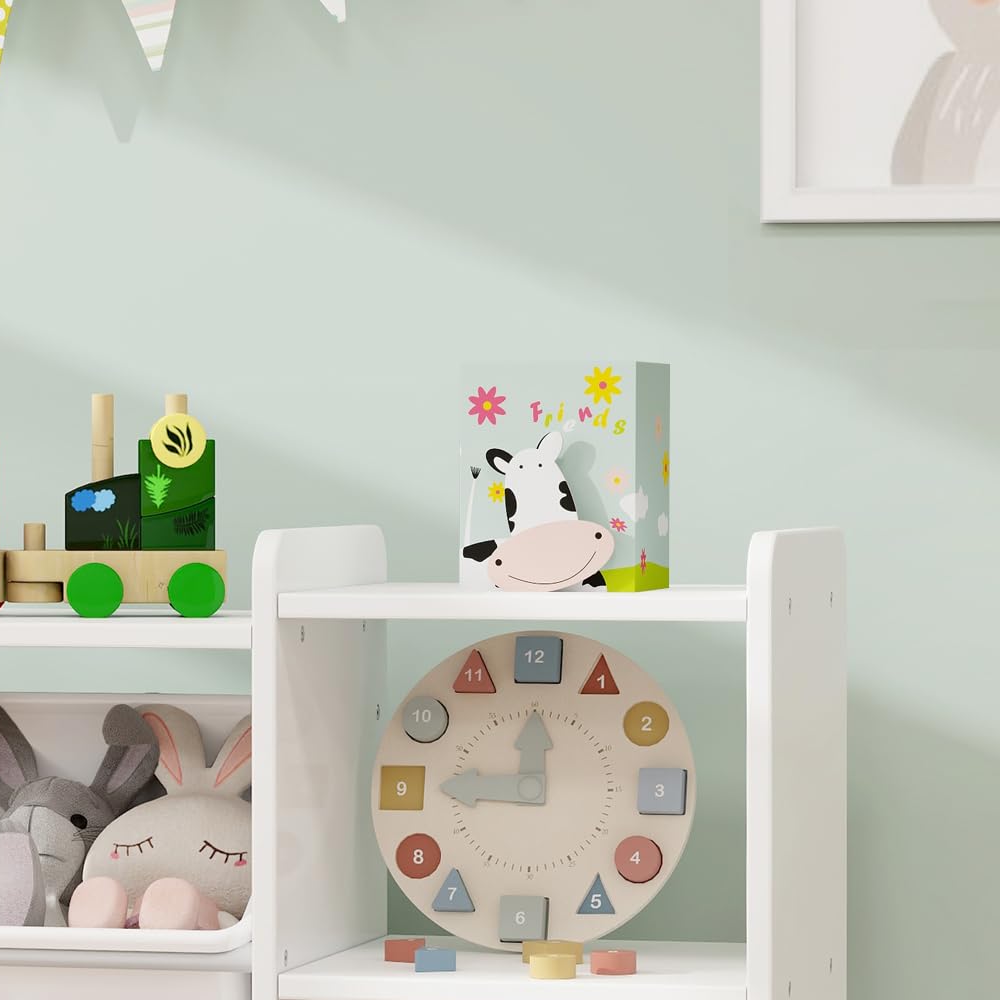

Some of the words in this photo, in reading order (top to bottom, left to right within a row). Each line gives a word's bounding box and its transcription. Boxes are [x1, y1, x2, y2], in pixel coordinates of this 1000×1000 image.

[530, 401, 627, 436] Friends
[523, 650, 545, 664] 12
[464, 668, 483, 682] 11
[596, 674, 607, 689] 1
[411, 709, 432, 724] 10
[641, 715, 653, 731] 2
[395, 781, 407, 796] 9
[654, 783, 665, 798] 3
[413, 849, 424, 865] 8
[629, 851, 641, 865] 4
[447, 887, 458, 900] 7
[590, 893, 602, 909] 5
[515, 910, 526, 926] 6
